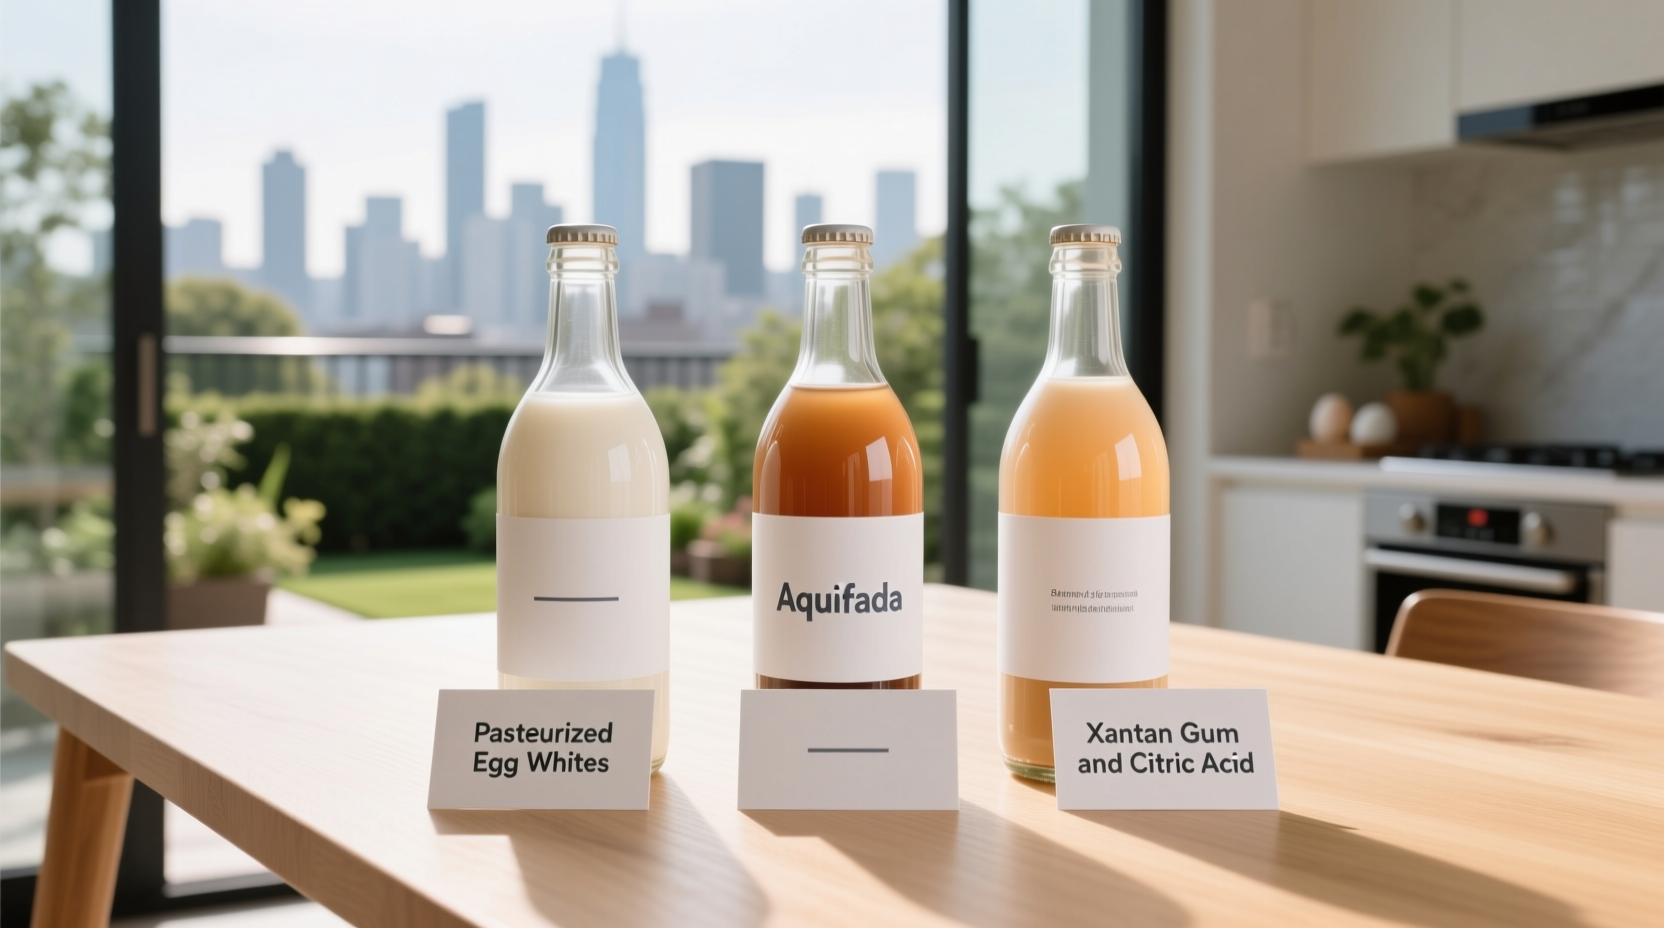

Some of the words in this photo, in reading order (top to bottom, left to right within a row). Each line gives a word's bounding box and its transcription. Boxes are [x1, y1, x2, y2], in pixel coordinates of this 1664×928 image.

[776, 581, 903, 622] Aquifada
[474, 721, 613, 744] Pasteurized
[1086, 721, 1173, 744] Xantan
[1180, 721, 1239, 744] Gum
[473, 751, 519, 778] Egg
[527, 751, 610, 774] Whites
[1078, 752, 1123, 774] and
[1130, 751, 1195, 774] Citric
[1201, 751, 1255, 774] Acid
